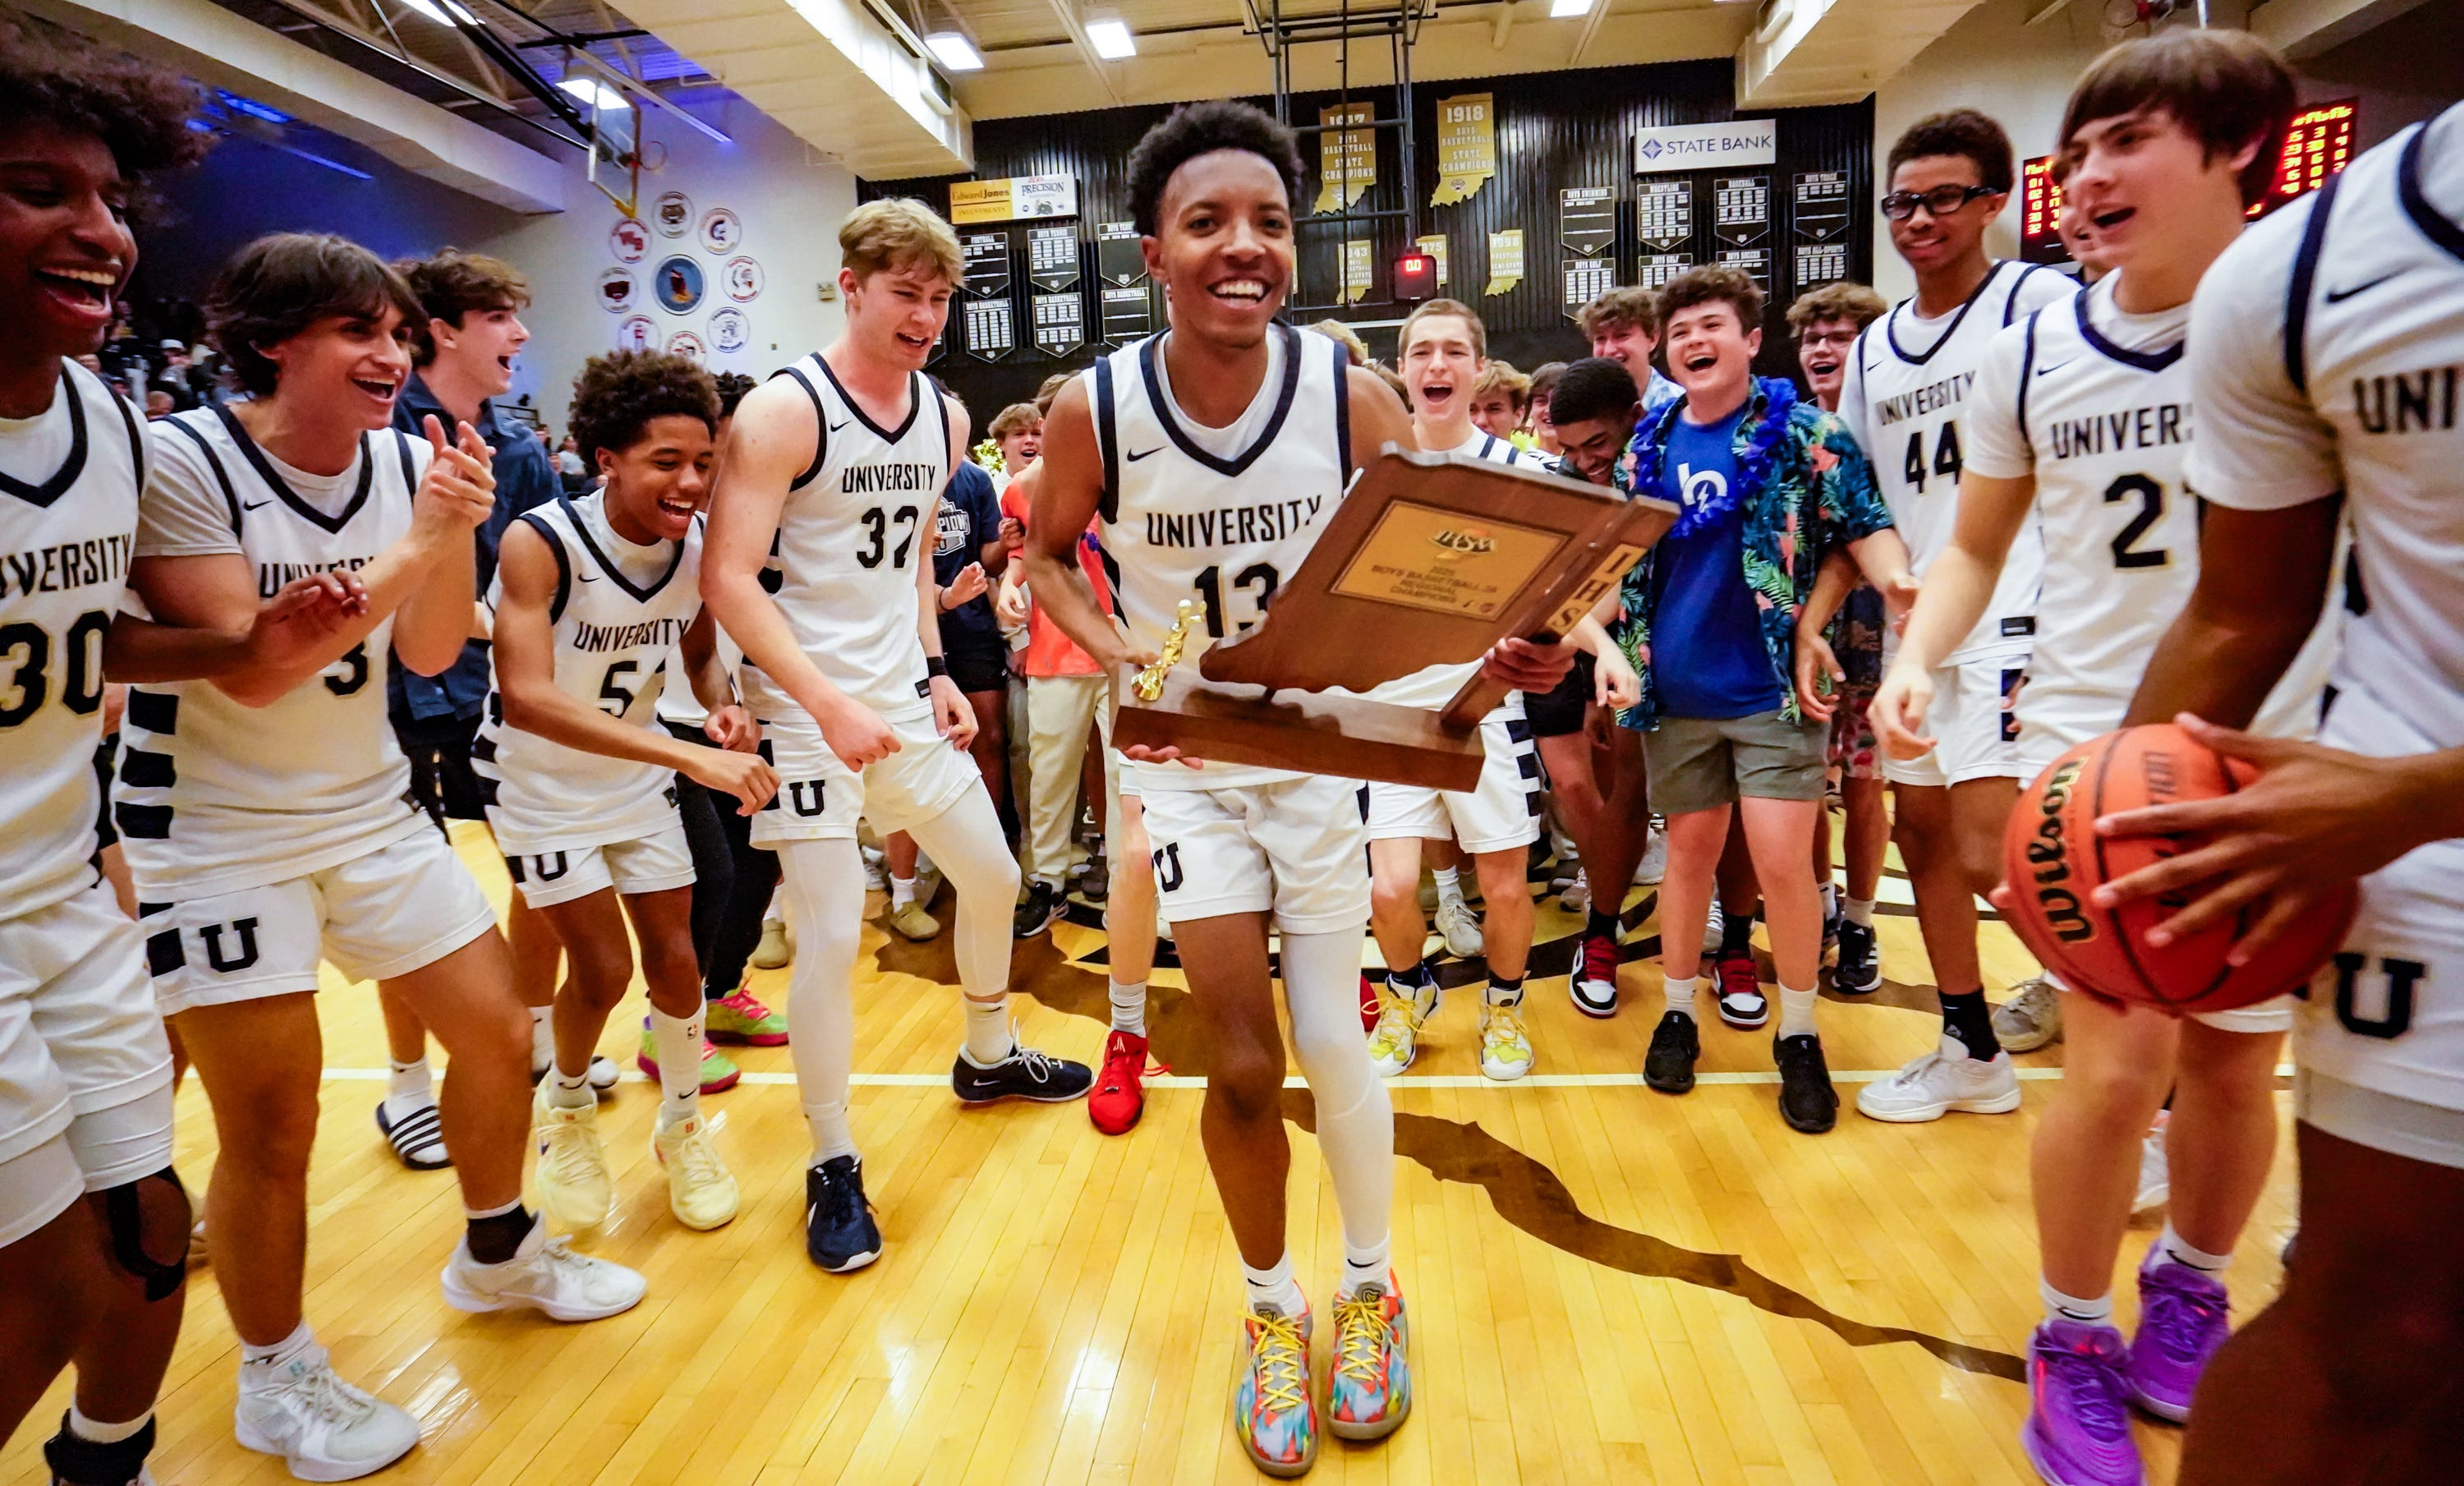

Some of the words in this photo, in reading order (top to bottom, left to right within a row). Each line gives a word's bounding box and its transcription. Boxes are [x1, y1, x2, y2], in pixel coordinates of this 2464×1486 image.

[1447, 105, 1483, 123] 1918
[1442, 135, 1492, 146] BASKETBALL
[1457, 126, 1475, 136] BOYS
[1666, 139, 1716, 154] STATE
[1722, 135, 1772, 150] BANK
[1443, 159, 1493, 172] CHAMPIONS
[1453, 149, 1481, 160] STATE
[1022, 182, 1064, 196] PRECISION
[1326, 168, 1373, 180] CHAPIONS
[1492, 237, 1519, 248] 1998
[1875, 369, 1977, 426] UNIVERSITY
[1905, 420, 1964, 494] 44
[842, 463, 935, 493] UNIVERSITY
[1147, 495, 1322, 548] UNIVERSITY
[2104, 473, 2191, 568] 2
[856, 504, 919, 568] 32
[1371, 564, 1404, 576] BOYS
[1406, 571, 1478, 590] BASKETBALL
[1400, 579, 1455, 596] REGIONAL
[1194, 562, 1279, 638] 13
[1390, 586, 1457, 603] CHAMPIONS
[573, 619, 692, 653] UNIVERSITY
[0, 610, 111, 727] 30
[789, 780, 825, 817] U
[2027, 756, 2093, 943] Wilson
[536, 851, 567, 881] U
[1152, 842, 1184, 893] U
[200, 918, 258, 973] U
[2333, 953, 2425, 1039] U
